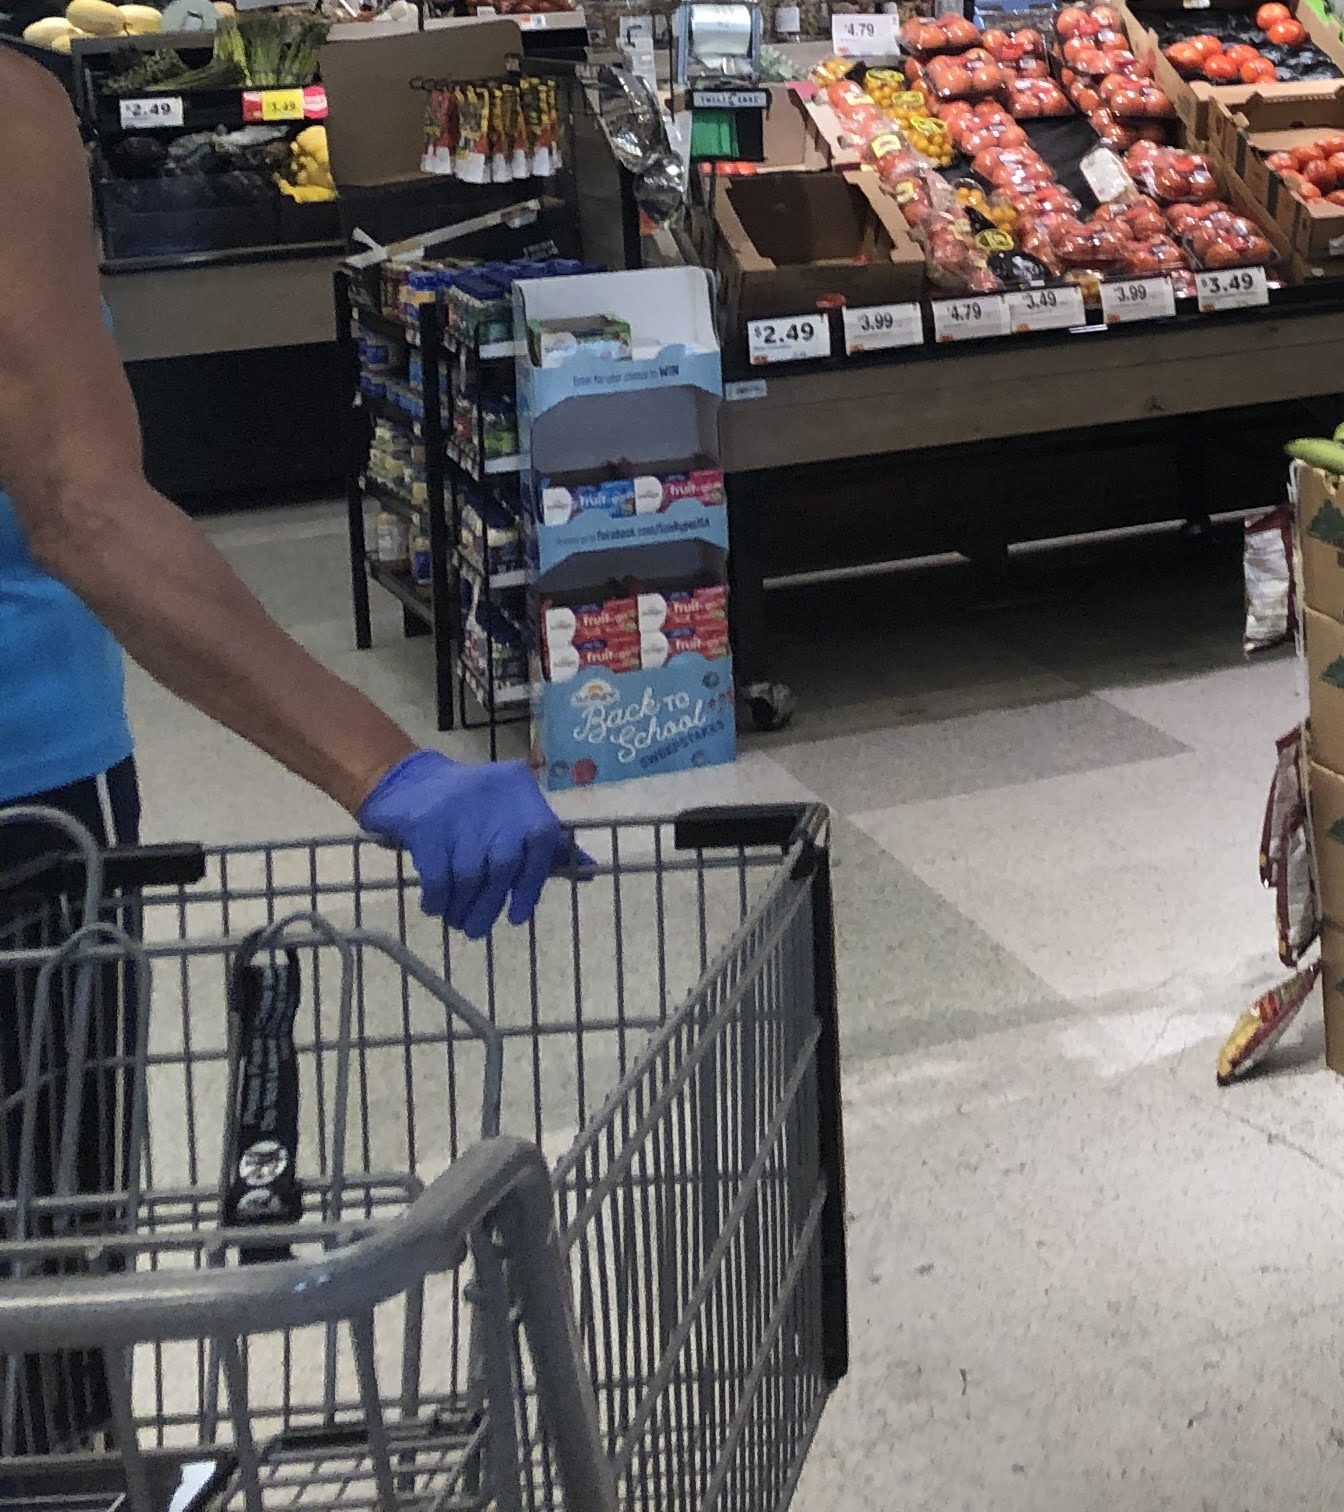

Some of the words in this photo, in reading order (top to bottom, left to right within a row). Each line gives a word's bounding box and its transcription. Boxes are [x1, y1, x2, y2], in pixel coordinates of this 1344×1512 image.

[1201, 273, 1254, 294] $3.49
[754, 322, 815, 344] $2.49
[659, 364, 680, 378] WIN
[573, 686, 661, 744] Back
[664, 692, 691, 712] TO
[610, 698, 706, 764] School
